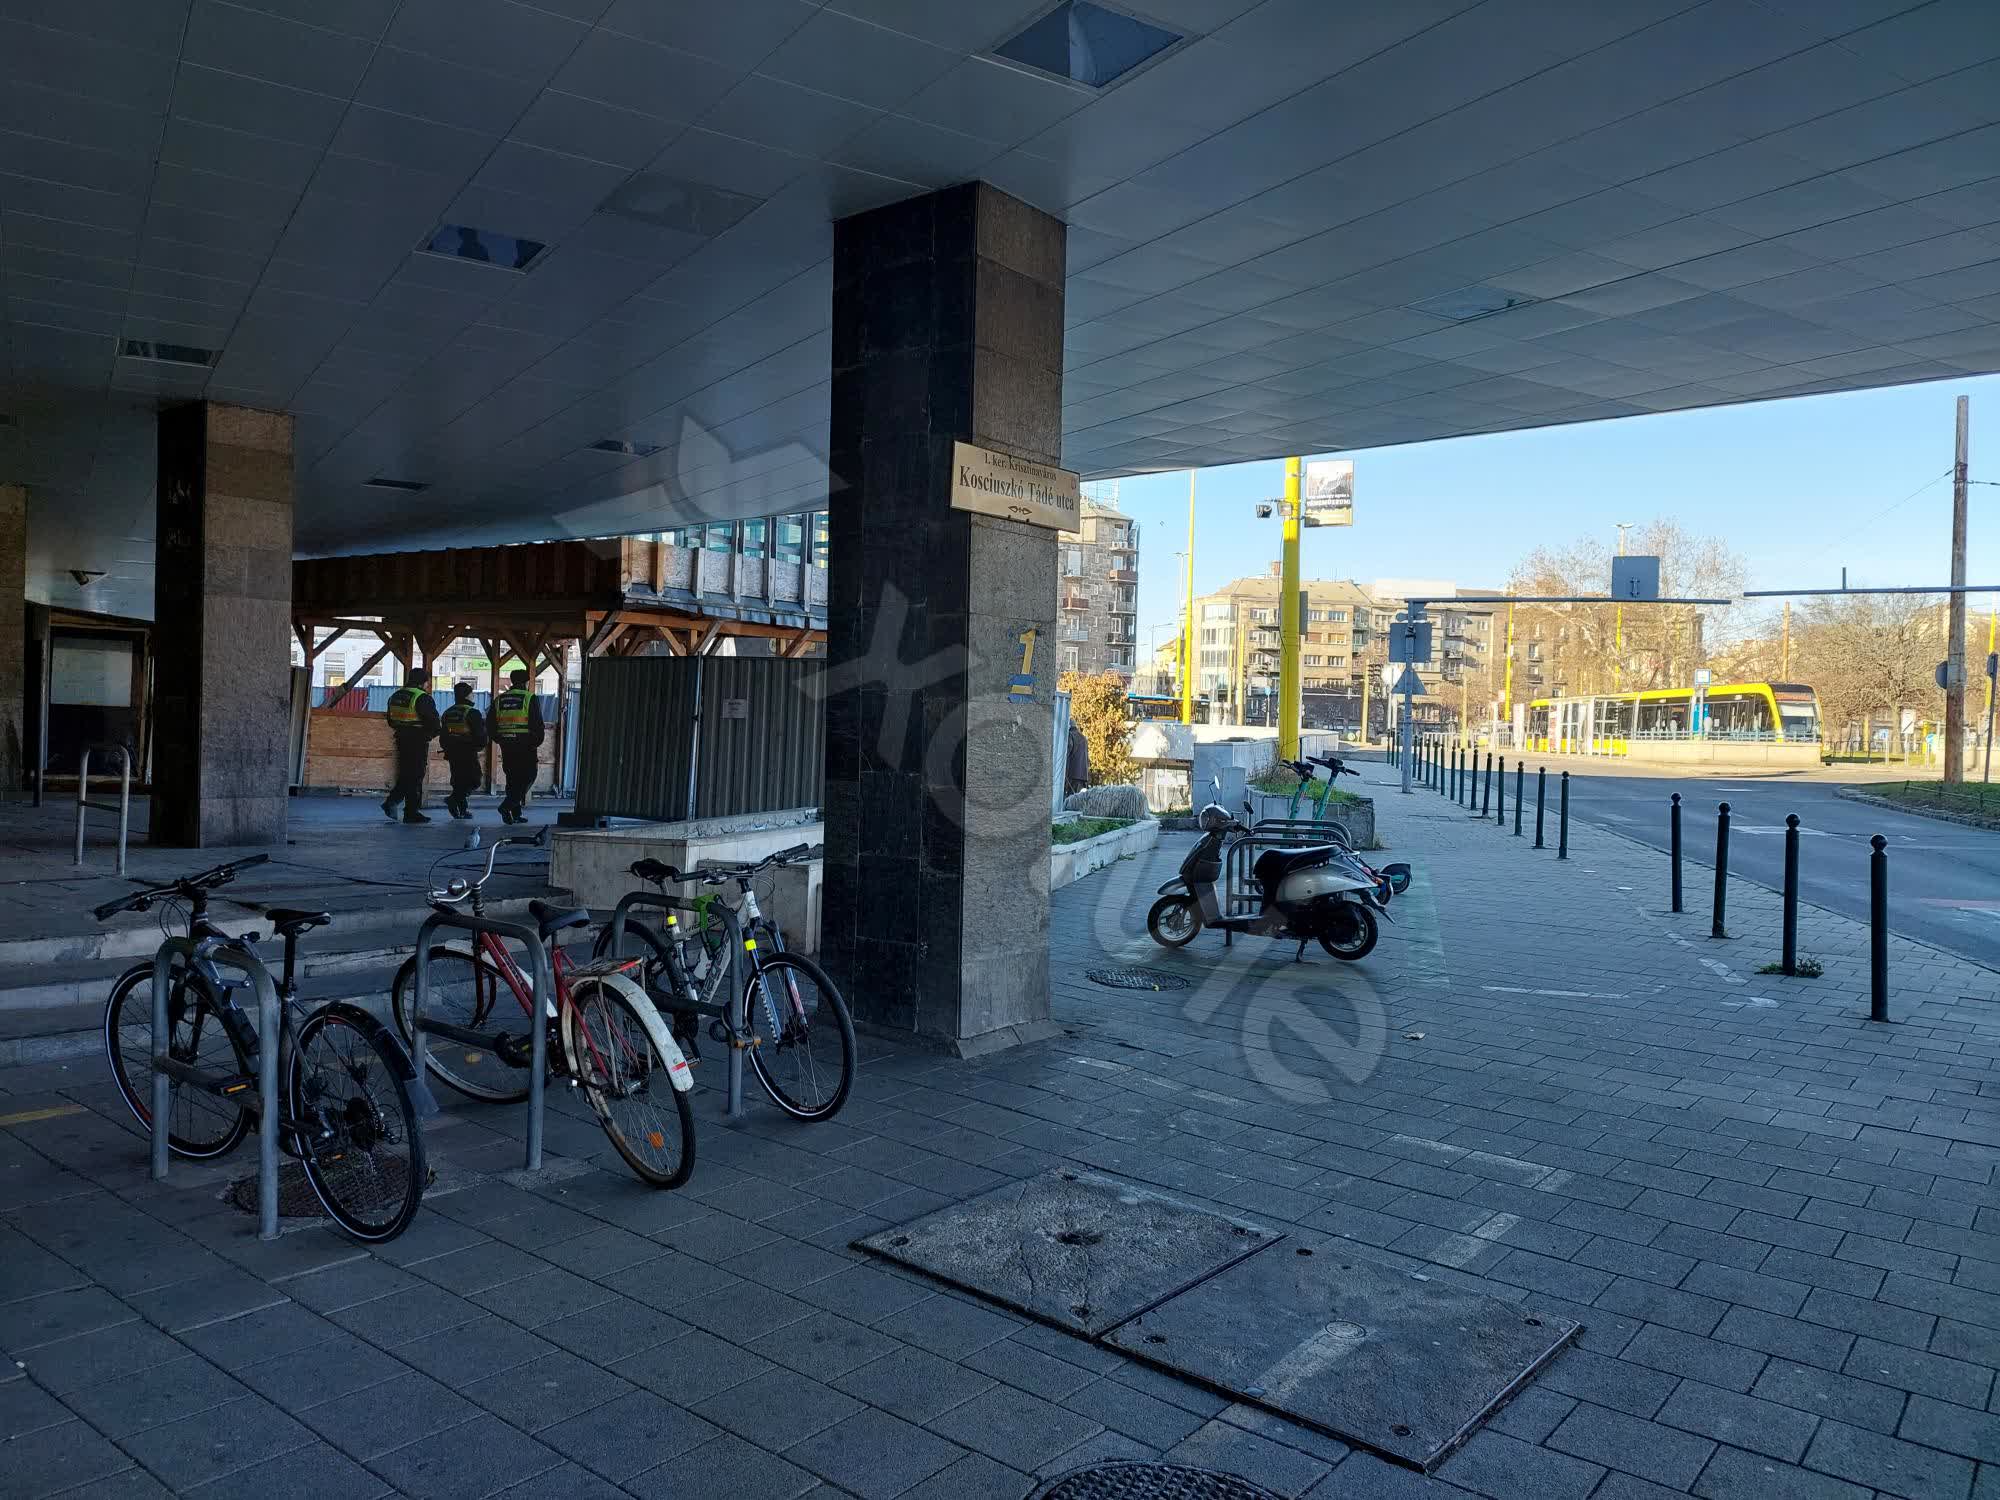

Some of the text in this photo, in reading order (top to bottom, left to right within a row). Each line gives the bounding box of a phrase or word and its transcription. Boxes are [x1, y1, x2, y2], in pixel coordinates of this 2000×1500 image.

[992, 455, 1007, 469] ker.
[1009, 457, 1057, 481] Krisztinaváros
[959, 465, 1075, 511] Kosciuszkó Tádé utca
